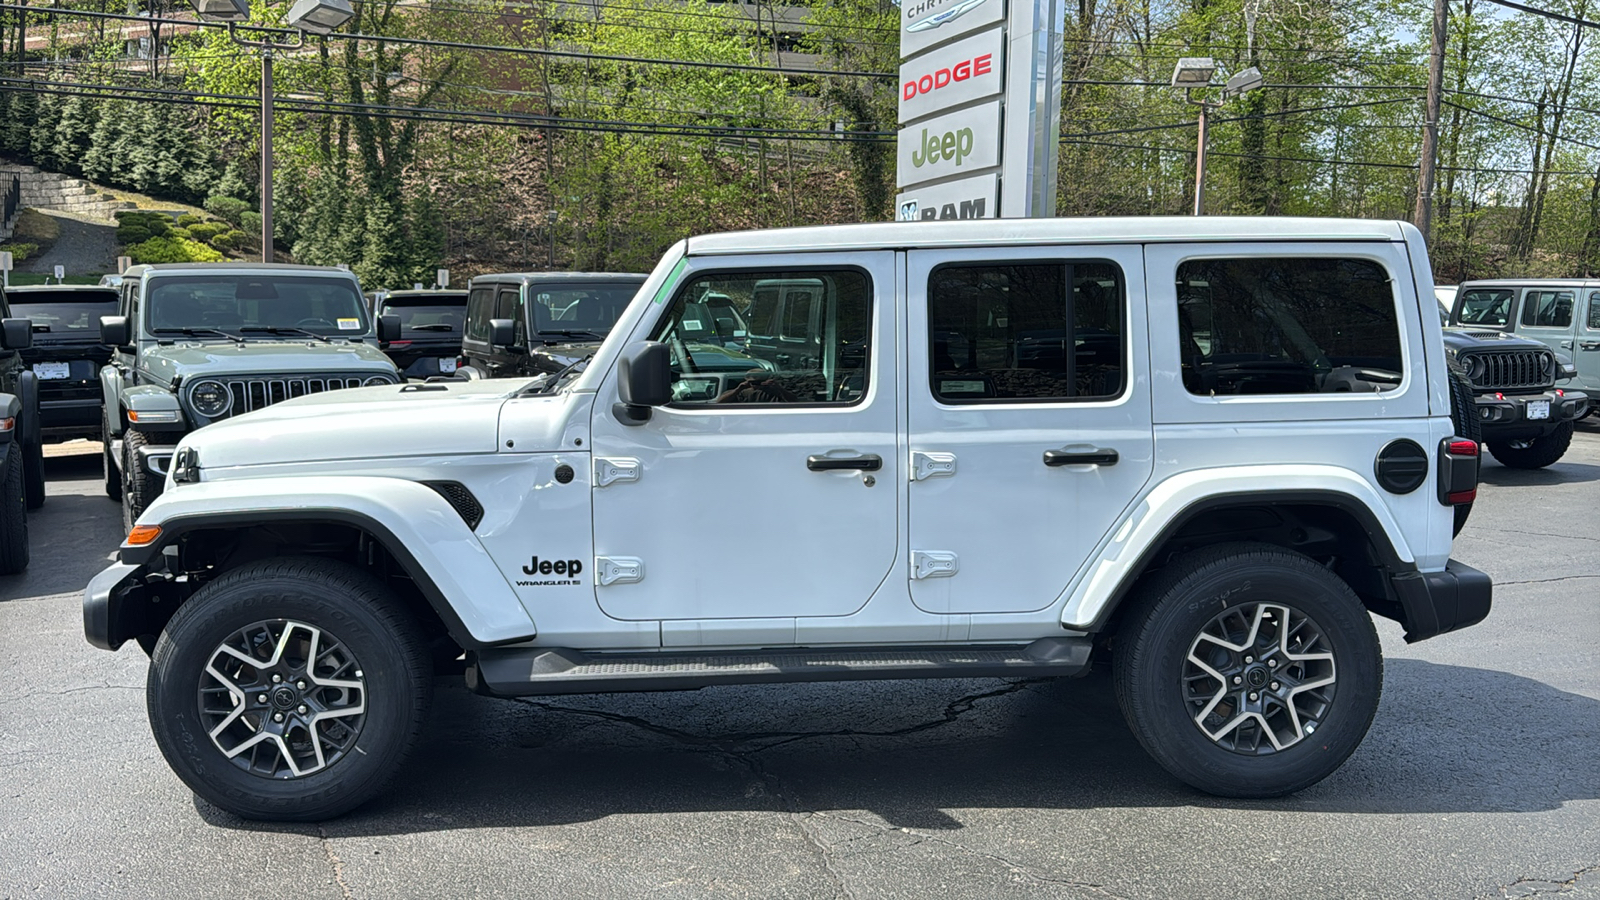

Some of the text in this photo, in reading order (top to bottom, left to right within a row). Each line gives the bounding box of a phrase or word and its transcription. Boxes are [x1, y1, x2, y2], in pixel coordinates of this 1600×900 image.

[903, 53, 992, 101] DODGE
[912, 127, 974, 168] Jeep
[921, 198, 986, 220] RAM
[522, 555, 583, 578] Jeep
